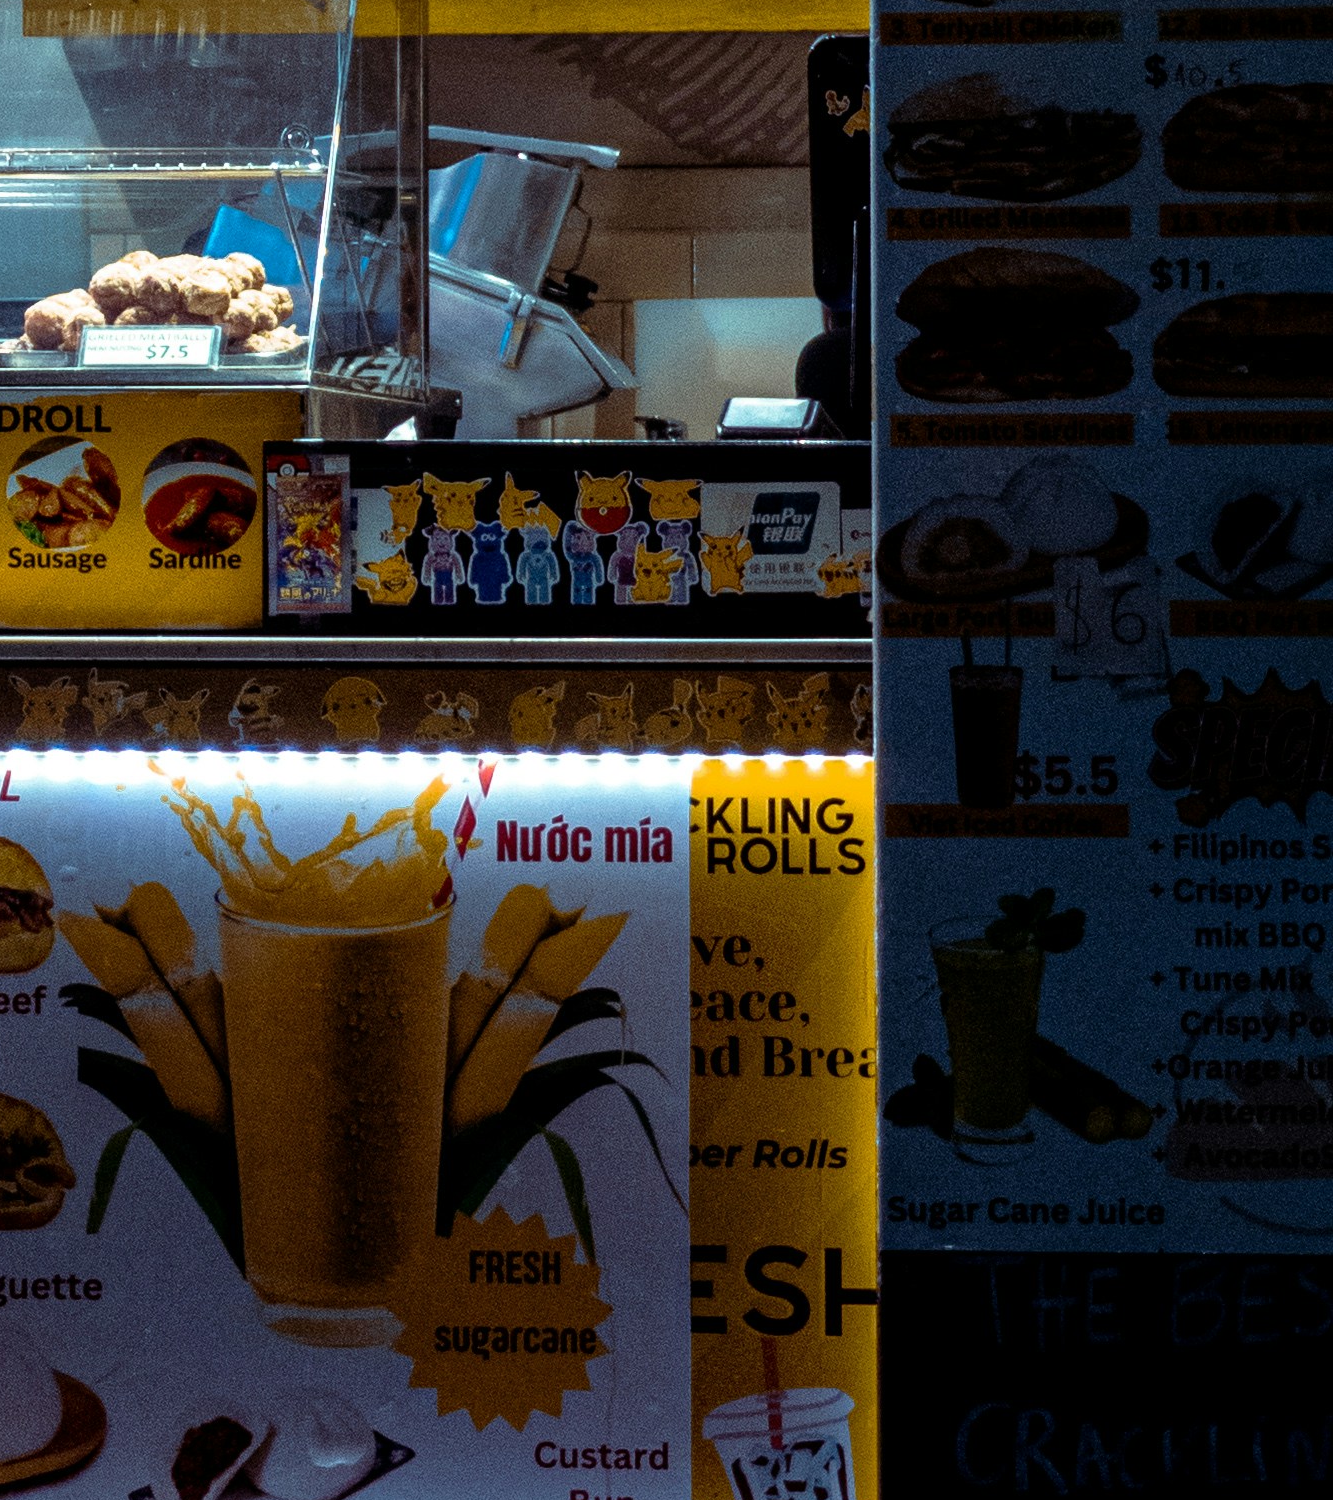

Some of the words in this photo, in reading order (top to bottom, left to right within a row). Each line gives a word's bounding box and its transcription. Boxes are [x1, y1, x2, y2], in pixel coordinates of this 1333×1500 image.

[8, 548, 107, 573] Sausage
[149, 548, 241, 570] Sardine
[1013, 750, 1118, 800] $5.5
[605, 818, 673, 863] mía
[707, 839, 866, 875] ROLLS
[753, 1140, 848, 1169] Rolls
[888, 1197, 979, 1229] Sugar
[988, 1199, 1069, 1225] Cane
[1078, 1197, 1165, 1225] Juice
[469, 1251, 561, 1285] FRESH
[434, 1326, 597, 1360] sugarcane
[535, 1442, 669, 1470] Custard
